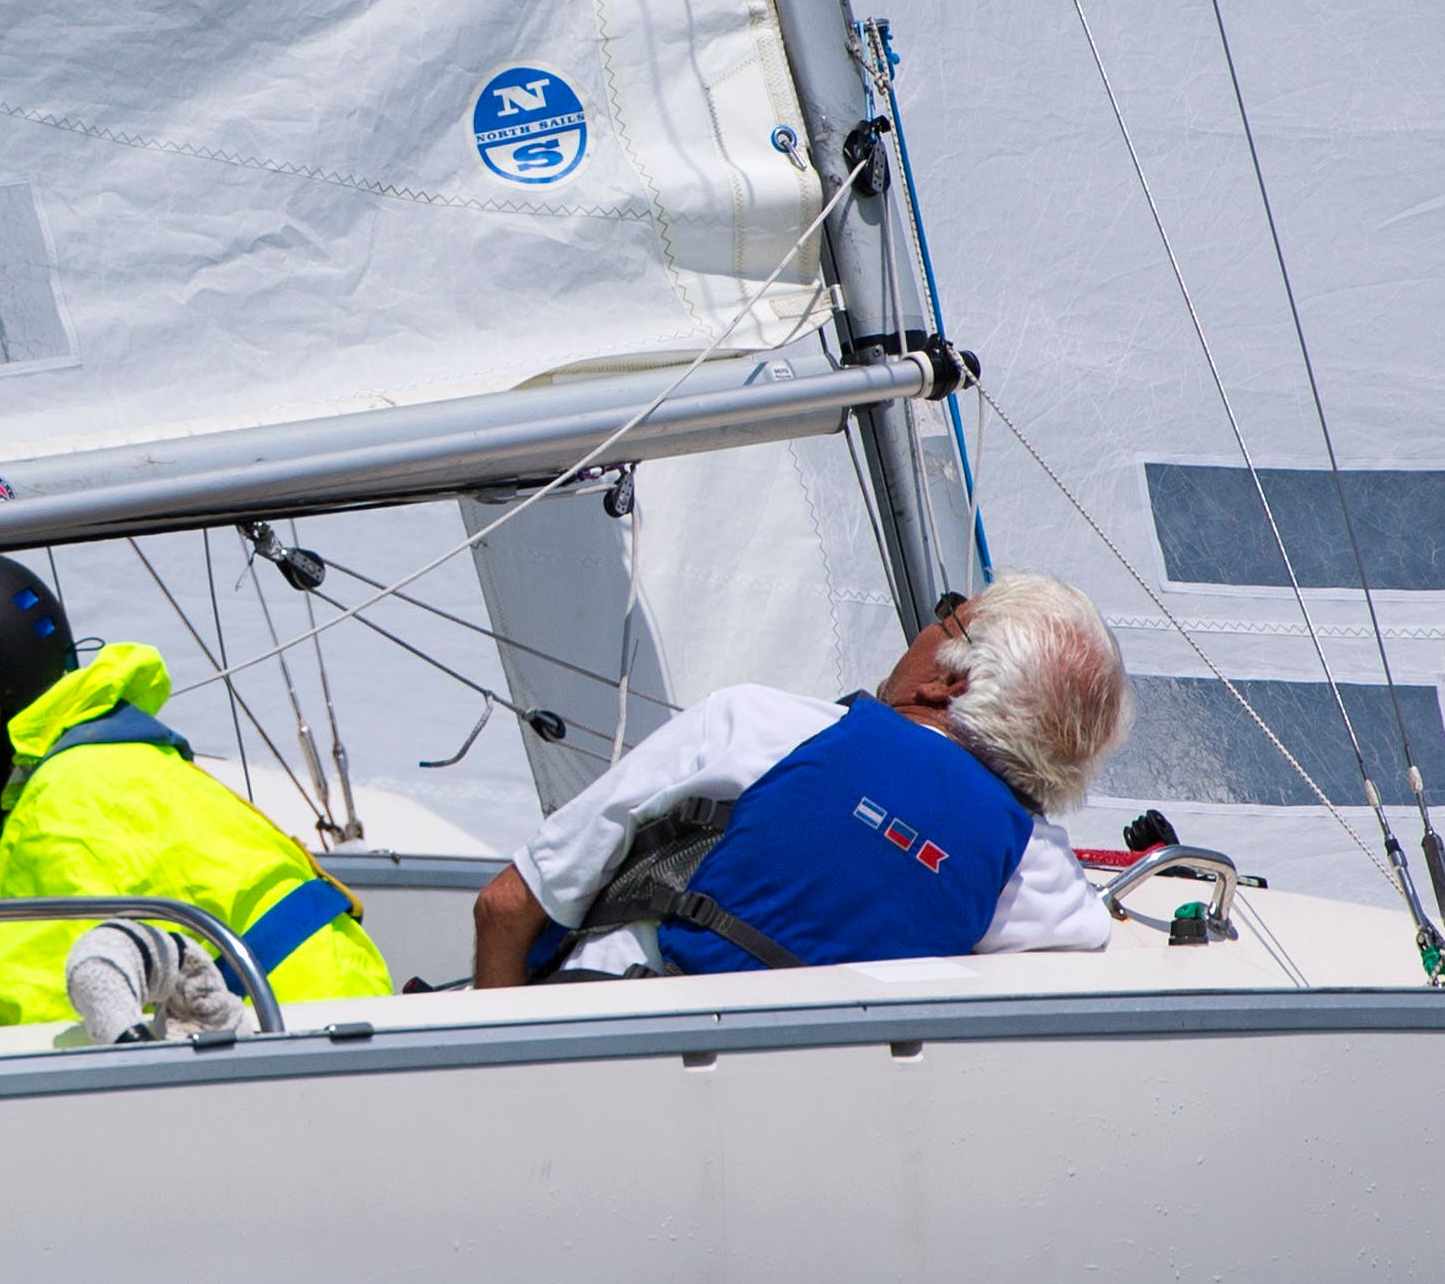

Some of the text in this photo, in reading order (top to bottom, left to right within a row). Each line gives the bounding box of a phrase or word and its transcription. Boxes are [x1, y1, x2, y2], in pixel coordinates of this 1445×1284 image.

[493, 78, 550, 117] N
[476, 113, 586, 143] NORTH SAILS
[513, 138, 564, 171] S
